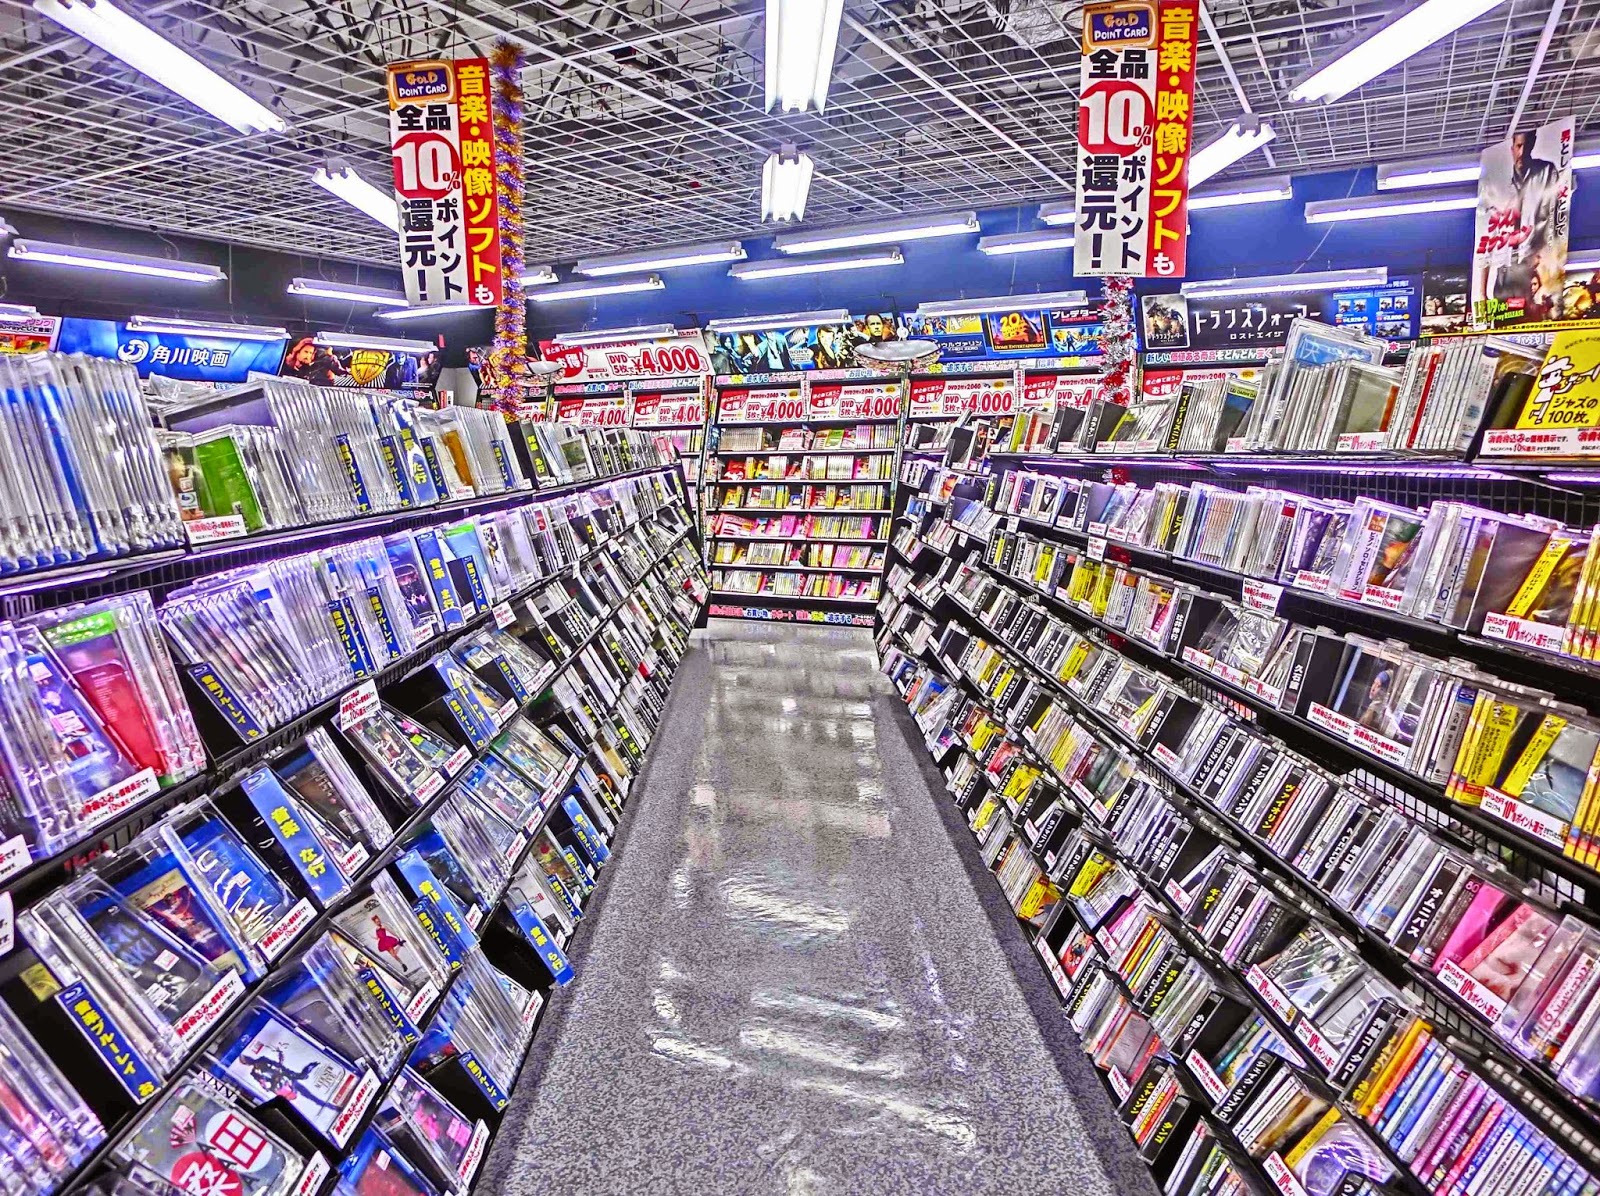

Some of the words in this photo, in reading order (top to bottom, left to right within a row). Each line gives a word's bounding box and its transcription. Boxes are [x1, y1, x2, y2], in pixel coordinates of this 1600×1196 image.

[1094, 29, 1122, 41] POINT
[1123, 26, 1148, 38] CARD
[1104, 13, 1139, 28] GOLD
[1089, 48, 1149, 79] 全品
[399, 86, 423, 98] POINT
[424, 83, 447, 96] CARD
[406, 72, 438, 86] GOLD
[397, 105, 451, 131] 全品
[1079, 90, 1152, 148] 10%
[1153, 7, 1195, 275] 音楽・映像ソフトも
[392, 140, 461, 191] 10%
[457, 65, 496, 305] 音楽・映像ソフトも
[1120, 155, 1147, 269] ポイント
[436, 198, 462, 301] ポイント
[150, 345, 231, 368] 角川映画
[609, 354, 628, 364] DVD
[633, 346, 701, 374] ¥4,000
[672, 404, 700, 423] ¥4,00
[761, 400, 803, 419] ¥4,000
[946, 396, 959, 404] DVD
[961, 392, 1012, 412] ¥4,000
[1554, 397, 1599, 408] ジャズの
[1167, 393, 1190, 449] イージーリスニング
[1548, 410, 1590, 424] 100枚。
[1171, 514, 1183, 535] ピアノ
[428, 557, 446, 580] 音楽
[368, 595, 396, 644] 音楽ブルーレイ
[331, 609, 359, 663] 音楽ブルーレイ
[200, 672, 248, 727] 音楽ブルーレイ
[449, 698, 479, 737] 音楽ブルーレイ
[1194, 734, 1228, 786] 1966カルテット
[1108, 793, 1130, 822] ワーグナー
[1259, 782, 1297, 831] ヴァイオリン
[268, 804, 301, 840] 音楽
[1201, 886, 1220, 911] ギター
[1406, 885, 1444, 938] オムニバス
[529, 925, 548, 946] 音楽
[365, 977, 407, 1030] 音楽ブルーレイ
[1146, 968, 1179, 1009] ボサ・ノヴァ
[73, 1000, 136, 1075] 音楽ブルーレイ
[1180, 1012, 1207, 1041] 小野リサ
[1129, 1080, 1156, 1116] シャンソン
[1217, 1058, 1267, 1120] ジェイク・シマブクロ
[1153, 1119, 1174, 1144] タンゴ
